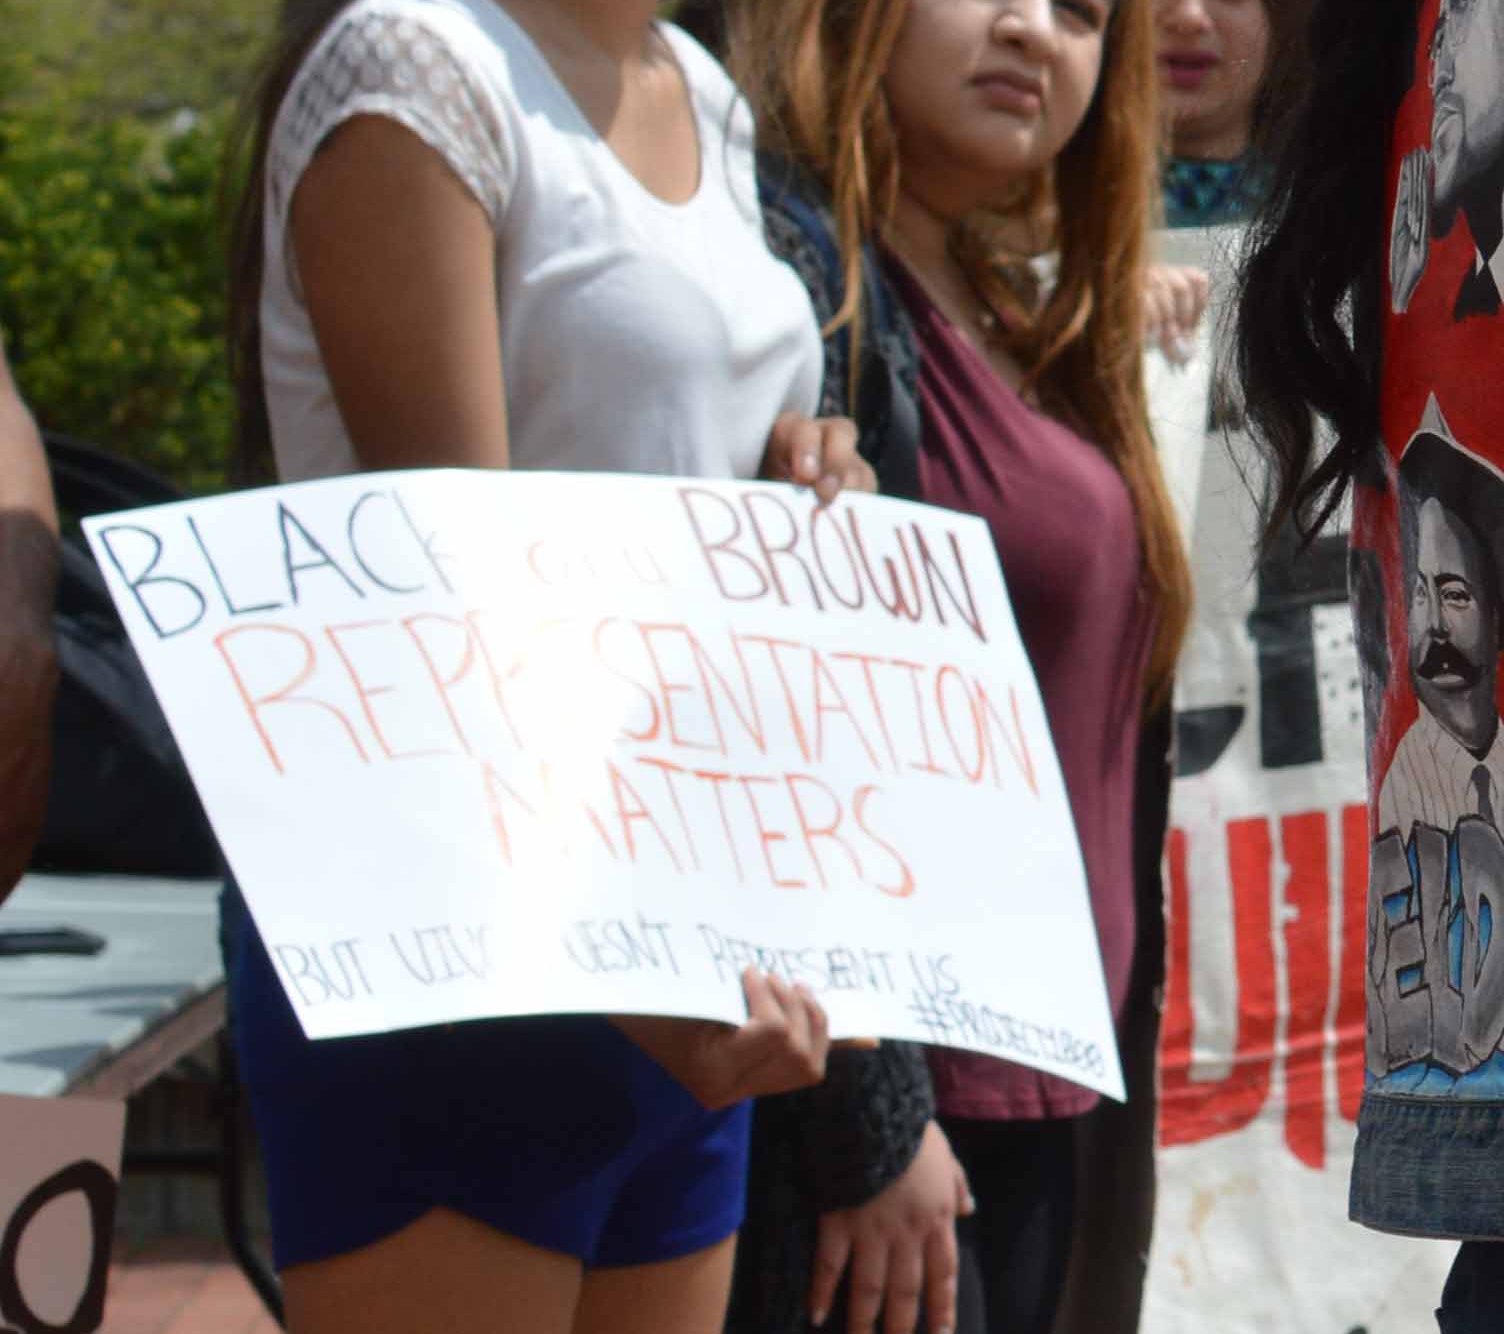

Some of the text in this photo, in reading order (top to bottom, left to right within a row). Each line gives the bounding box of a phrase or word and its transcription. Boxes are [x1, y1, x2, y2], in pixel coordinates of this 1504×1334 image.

[679, 487, 988, 644] BROWN
[214, 616, 1042, 800] REPSENTATION
[273, 938, 376, 1008] BUT
[910, 950, 961, 1001] US
